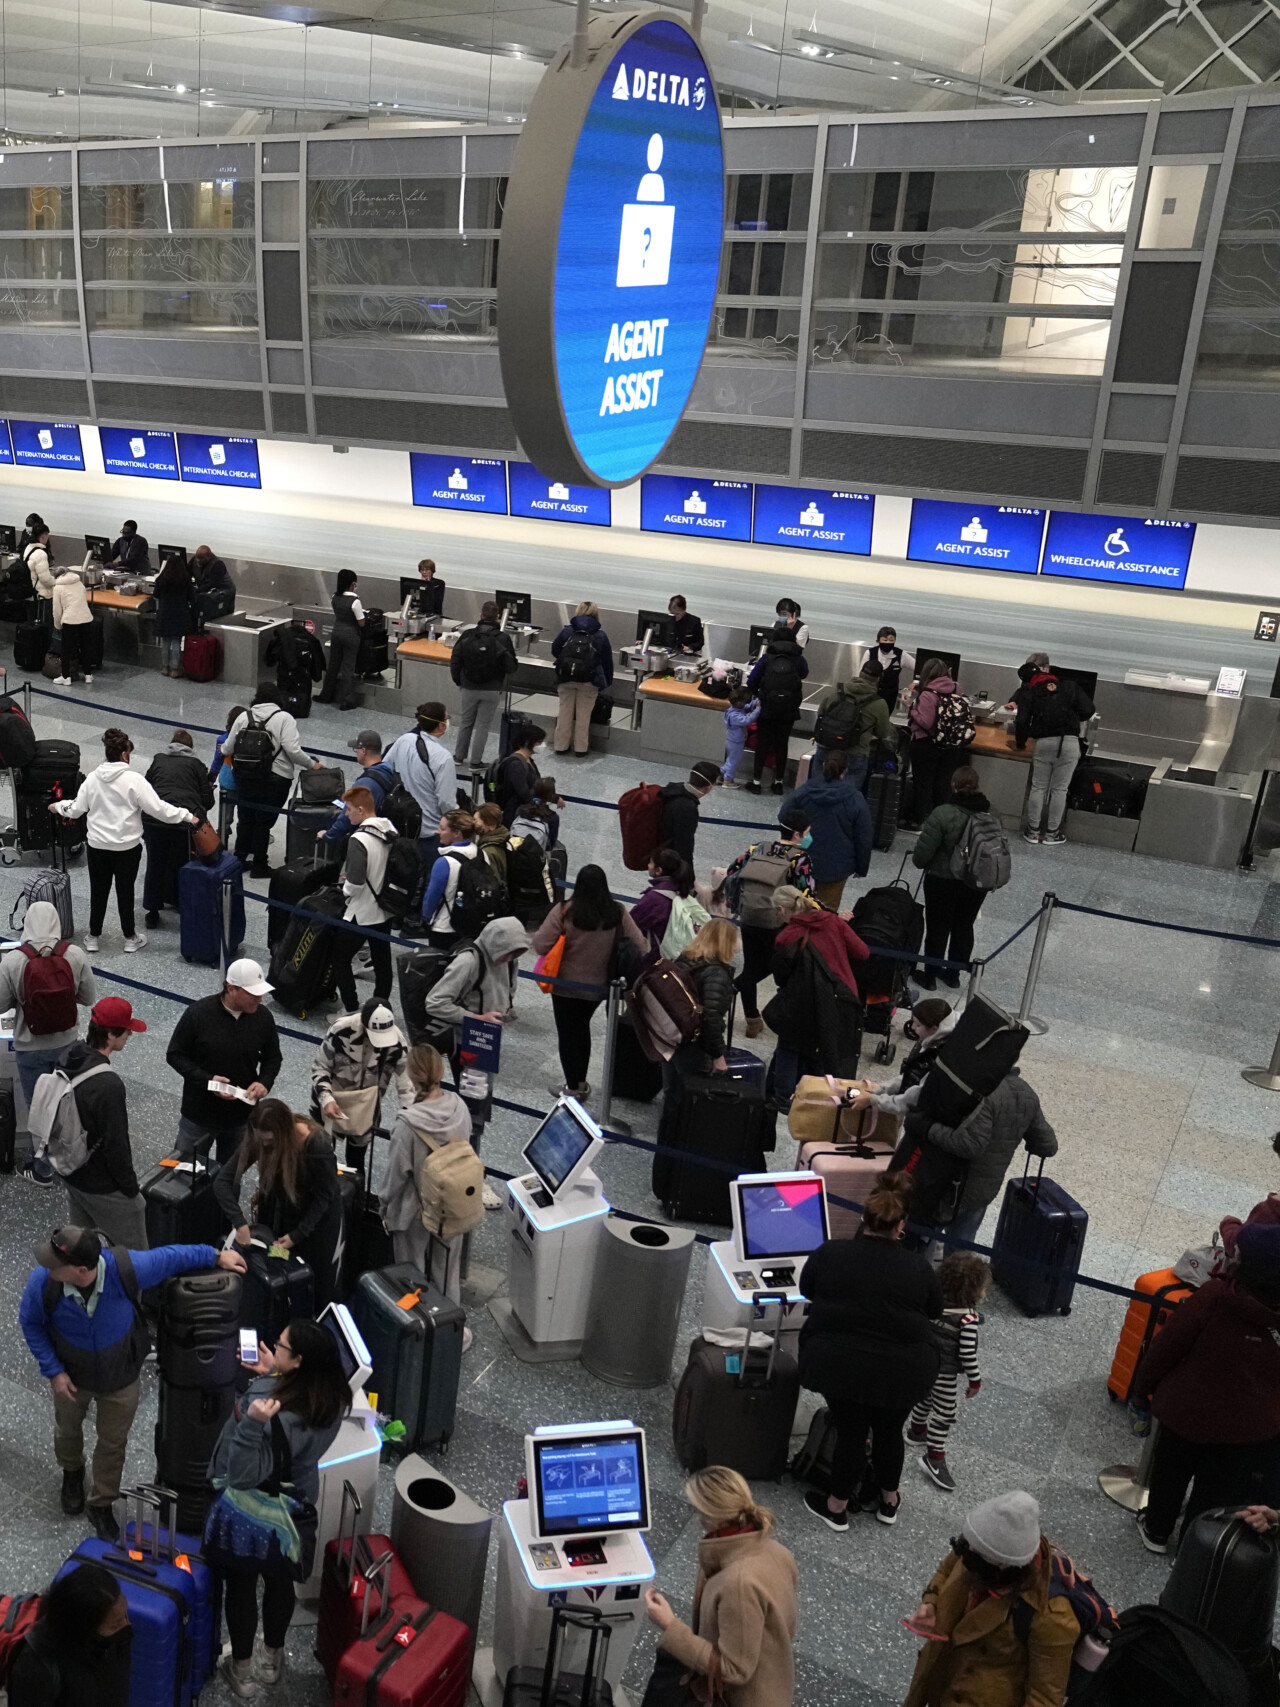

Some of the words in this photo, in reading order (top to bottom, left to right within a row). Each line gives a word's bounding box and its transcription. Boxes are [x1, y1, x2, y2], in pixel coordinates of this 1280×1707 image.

[632, 68, 690, 107] DELTA
[405, 189, 428, 201] Lake
[604, 318, 669, 364] AGENT
[599, 369, 664, 416] ASSIST
[17, 451, 56, 460] INTERNATIONAL
[106, 459, 148, 469] INTERNATIONAL
[149, 462, 175, 471] CHECK-IN
[183, 466, 228, 477] INTERNATIONAL
[229, 470, 257, 479] CHECK-IN
[432, 490, 458, 500] AGENT
[459, 493, 486, 502] ASSIST
[530, 500, 559, 510] AGENT
[560, 503, 588, 513] ASSIST
[1006, 507, 1033, 515] DELTA
[664, 514, 694, 525] AGENT
[696, 517, 727, 528] ASSIST
[1153, 519, 1182, 528] DELTA
[778, 526, 811, 538] AGENT
[812, 530, 846, 541] ASSIST
[935, 542, 972, 555] AGENT
[973, 546, 1011, 559] ASSIST
[1050, 554, 1115, 570] WHEELCHAIR
[1116, 561, 1180, 577] ASSISTANCE
